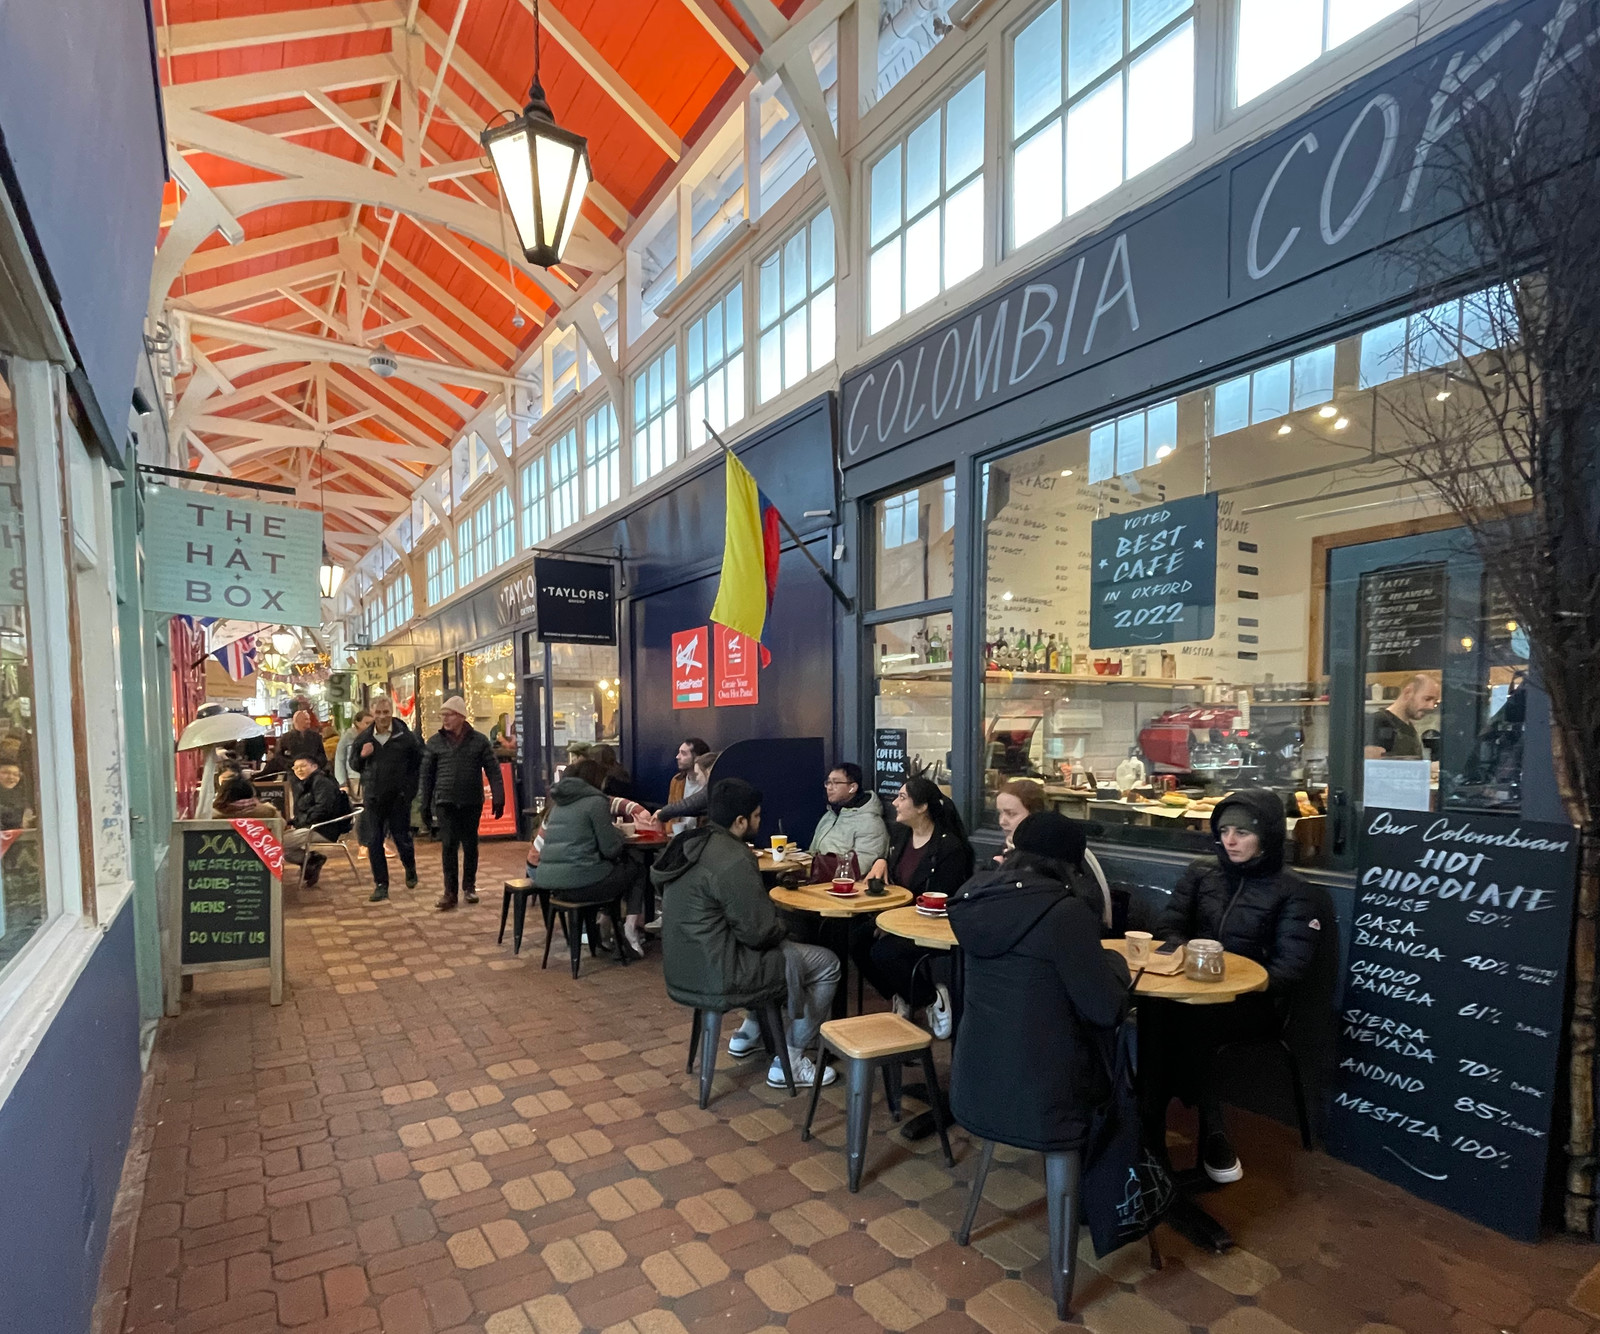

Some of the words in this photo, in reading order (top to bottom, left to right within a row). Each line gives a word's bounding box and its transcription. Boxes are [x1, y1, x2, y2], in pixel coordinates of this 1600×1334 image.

[847, 233, 1140, 457] COLOMBIA
[187, 503, 286, 539] THE
[1124, 510, 1171, 530] VOTED
[186, 541, 286, 574] HAT
[1115, 525, 1186, 558] BEST
[186, 580, 286, 611] BOX
[548, 586, 604, 600] TAYLORS
[1104, 590, 1121, 602] IN
[1131, 580, 1193, 599] OXFORD
[1114, 602, 1185, 628] 2022
[876, 748, 904, 759] COFFEE
[876, 760, 905, 772] BEANS
[1368, 812, 1417, 835] Our
[1423, 818, 1569, 852] Colombian
[188, 859, 207, 871] WE
[207, 859, 231, 870] ARE
[232, 859, 263, 871] OPEN
[1414, 849, 1493, 876] HOT
[1362, 866, 1556, 911] CHOCOLATE
[1355, 914, 1424, 937] CASA
[1362, 893, 1430, 912] HOUSE
[1466, 910, 1513, 928] 50%
[190, 931, 207, 944] DO
[211, 931, 245, 944] VISIT
[249, 931, 265, 944] US
[1354, 929, 1447, 962] BLANCA
[1462, 955, 1509, 975] 40%
[1351, 961, 1421, 986] CHOCO
[1351, 974, 1436, 1008] PANELA
[1457, 1003, 1503, 1024] 61%
[1343, 1009, 1431, 1043] SIERRA
[1343, 1025, 1439, 1064] NEVADA
[1459, 1059, 1502, 1083] 70%
[1339, 1057, 1425, 1093] ANDINO
[1454, 1097, 1512, 1126] 85%
[1335, 1093, 1441, 1143] MESTIZA
[1451, 1136, 1511, 1169] 100%
